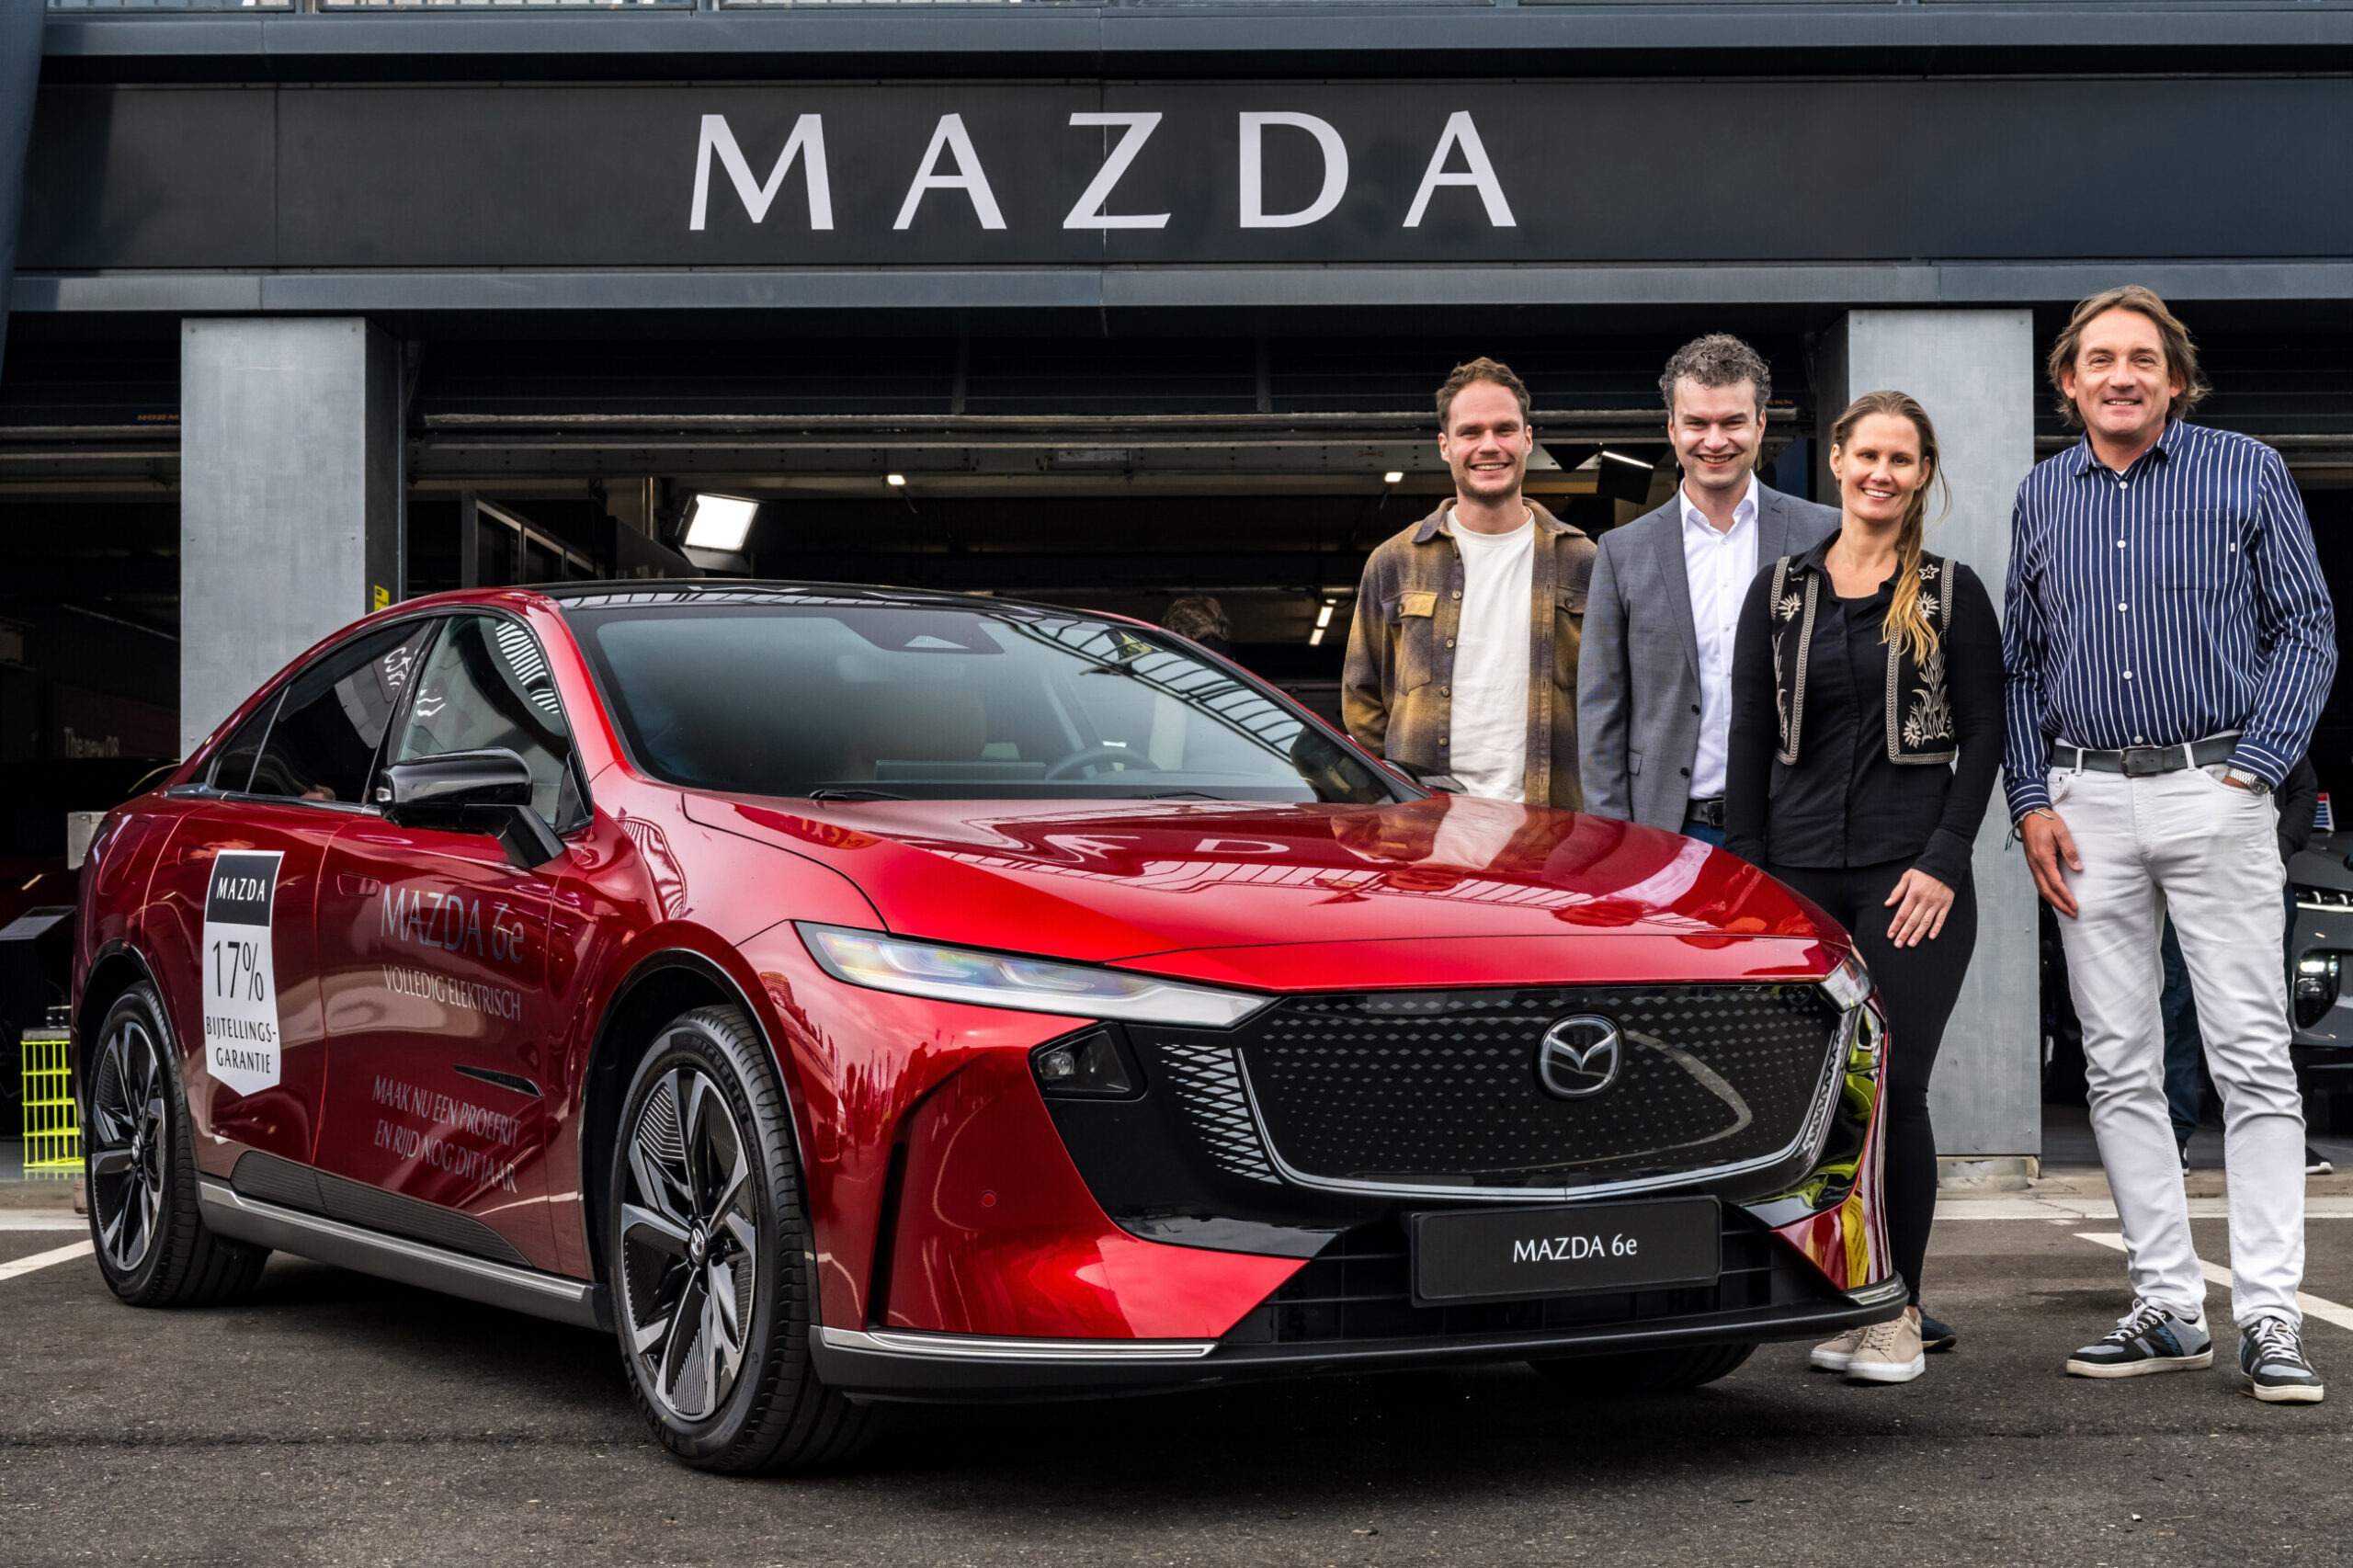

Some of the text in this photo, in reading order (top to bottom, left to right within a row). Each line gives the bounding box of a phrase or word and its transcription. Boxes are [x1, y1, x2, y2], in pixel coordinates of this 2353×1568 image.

[688, 109, 1518, 232] MAZDA
[216, 877, 266, 903] MAZDA
[381, 885, 524, 964] MAZDA 6e
[212, 940, 264, 1002] 17%
[382, 964, 521, 1021] VOLLEDIG ELEKTRISCH
[206, 1016, 277, 1043] BIJTELLINGS-
[216, 1047, 271, 1074] GARANTIE
[691, 1036, 748, 1117] MICHELIN
[371, 1074, 521, 1148] MAAK NU EEN PROEFRIT
[374, 1119, 517, 1194] EN RIJD NOG DIT JAAR
[1513, 1233, 1637, 1264] MAZDA 6e
